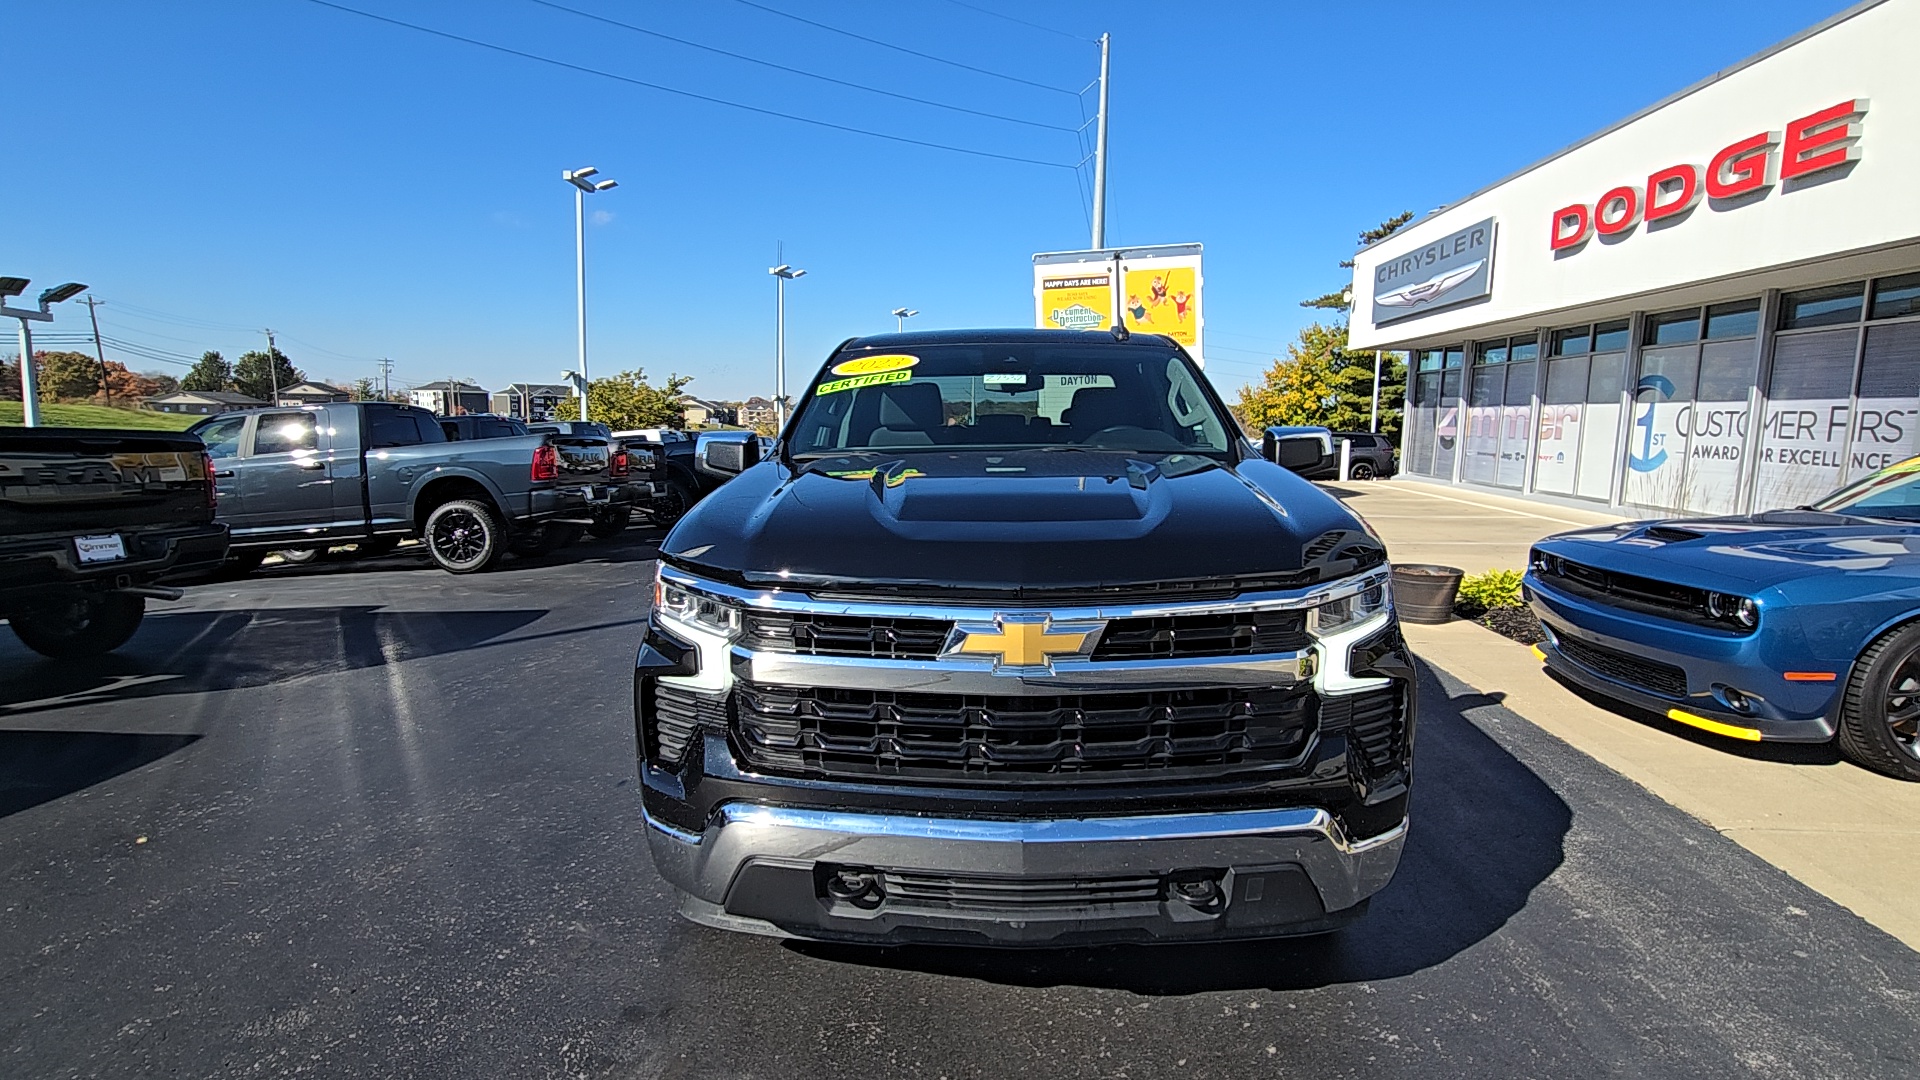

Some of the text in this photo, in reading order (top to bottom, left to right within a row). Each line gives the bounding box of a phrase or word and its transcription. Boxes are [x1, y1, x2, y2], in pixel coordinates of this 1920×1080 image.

[1551, 99, 1869, 250] DODGE
[1377, 228, 1485, 284] CHRYSLER
[1060, 314, 1103, 327] Destruction
[819, 372, 907, 393] CERTIFIED
[1060, 375, 1098, 386] DAYTON
[1438, 405, 1577, 440] Zmmer
[1692, 445, 1740, 460] AWARD
[1779, 448, 1892, 470] EXCELLNCE
[22, 465, 161, 485] RAM
